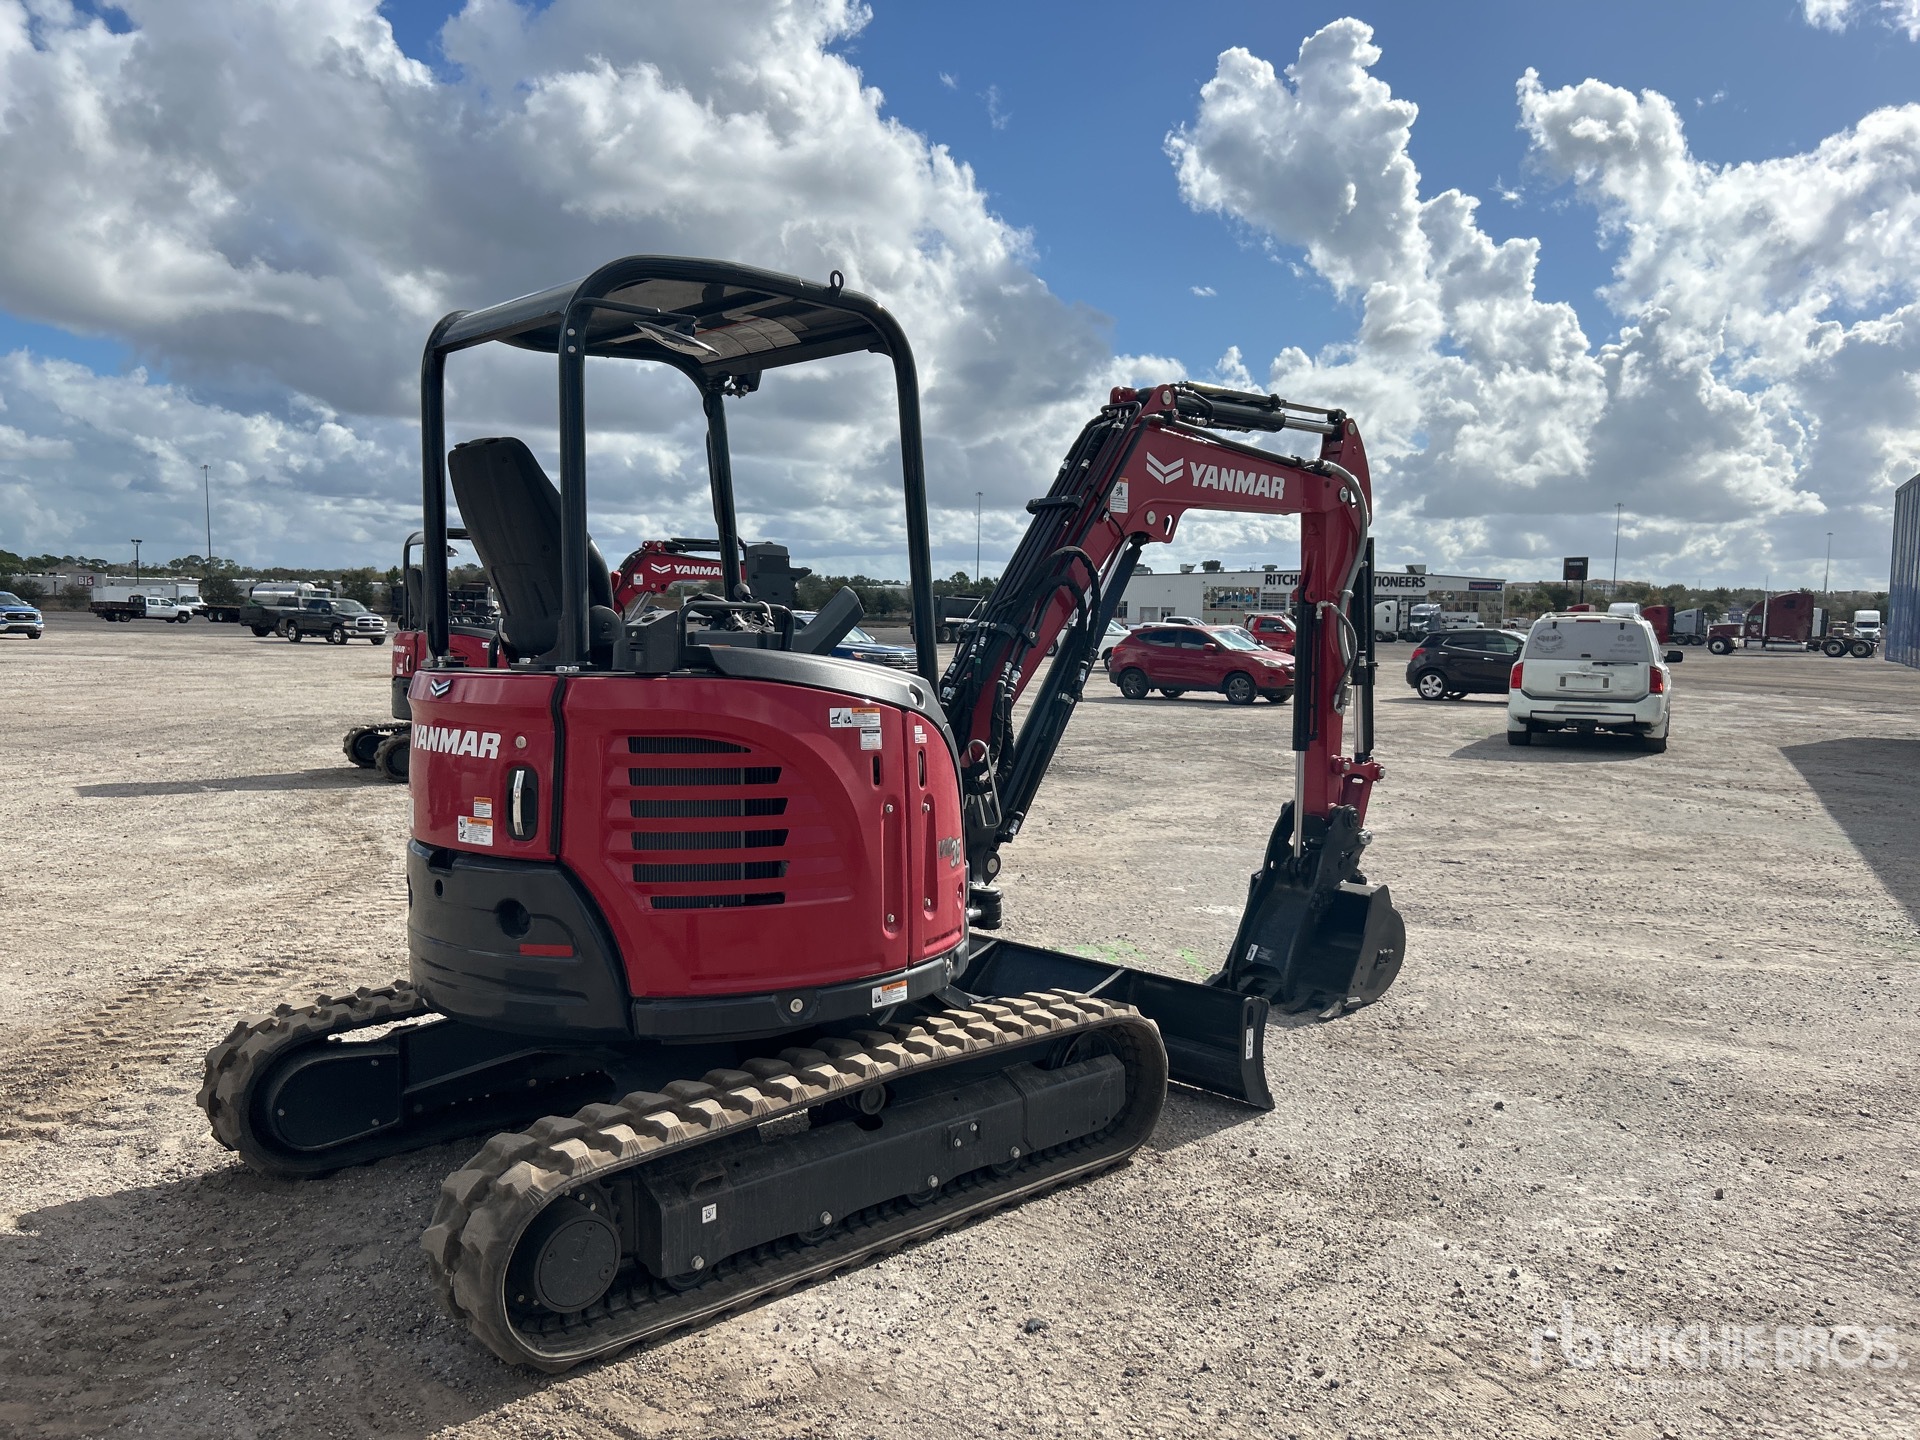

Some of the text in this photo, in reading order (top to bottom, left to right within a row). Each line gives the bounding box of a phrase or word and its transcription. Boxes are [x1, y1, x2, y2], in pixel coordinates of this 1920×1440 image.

[1189, 461, 1286, 500] YANMAR
[673, 564, 723, 576] YANMA
[1264, 573, 1426, 588] RITCH TIONEERS
[414, 723, 502, 760] YANMAR
